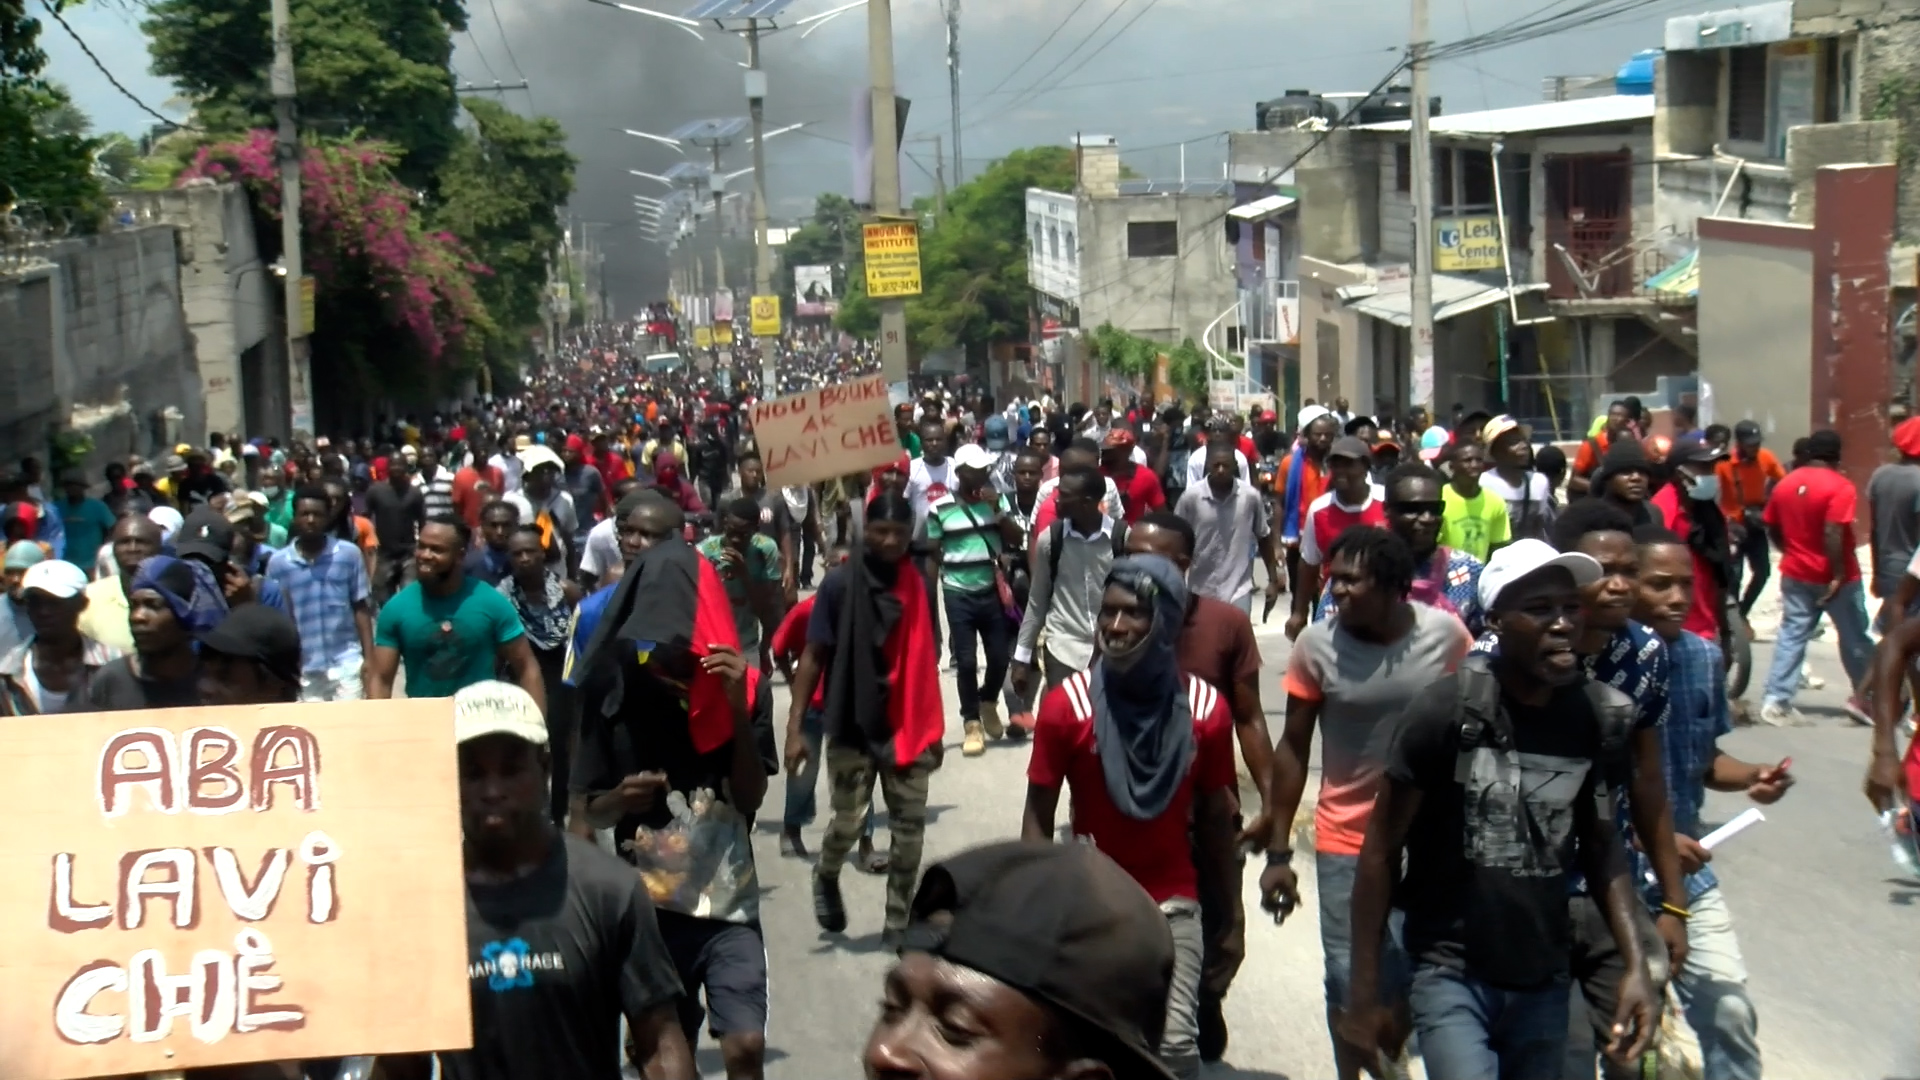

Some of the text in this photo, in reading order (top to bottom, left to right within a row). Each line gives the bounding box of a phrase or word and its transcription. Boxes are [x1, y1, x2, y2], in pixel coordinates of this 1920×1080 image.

[866, 224, 916, 238] INNOVATION
[866, 237, 914, 249] INSTITUTE
[1458, 244, 1503, 258] Center
[756, 378, 887, 425] NOU BOUKE
[802, 413, 838, 433] AK
[766, 436, 829, 472] LAVI
[97, 725, 321, 816] ABA
